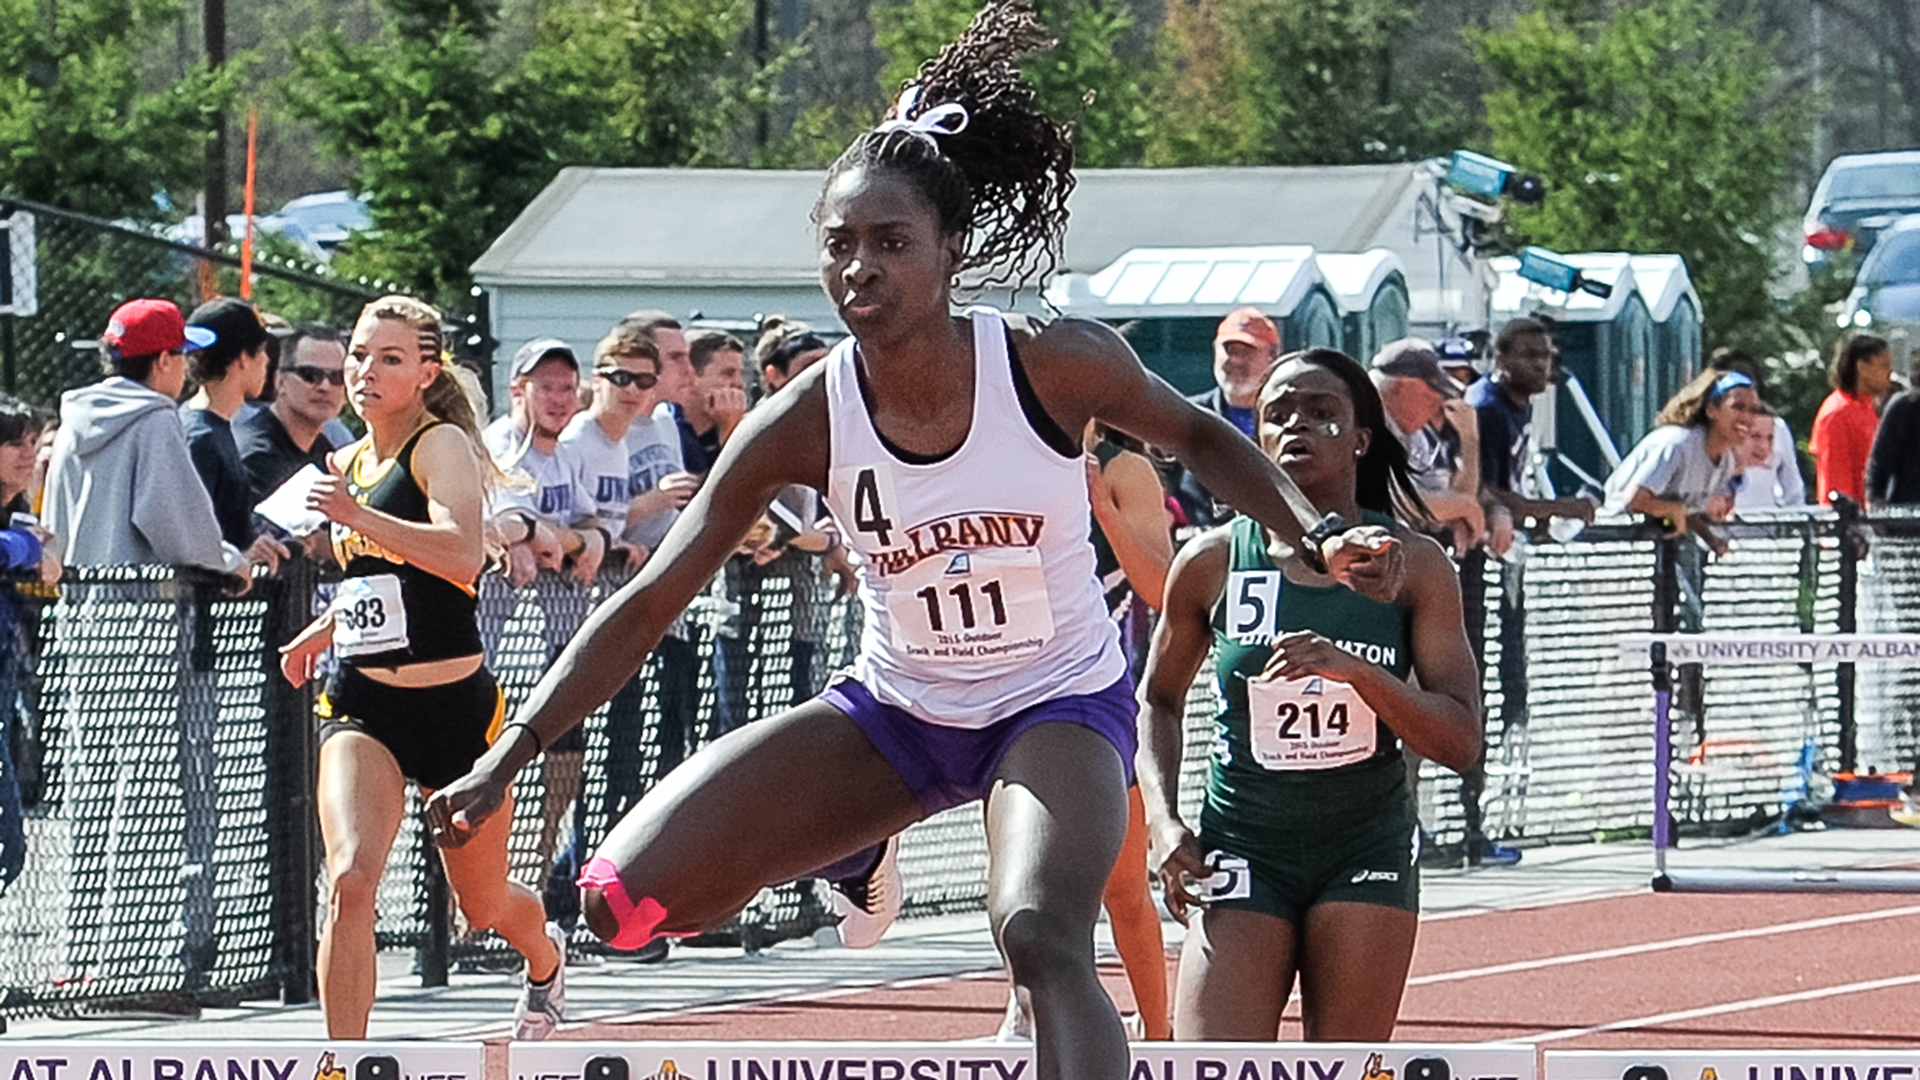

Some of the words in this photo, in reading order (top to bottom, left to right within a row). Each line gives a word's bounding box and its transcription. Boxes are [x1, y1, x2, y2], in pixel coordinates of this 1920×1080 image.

[854, 469, 893, 546] 4
[916, 580, 1006, 631] 111
[1237, 576, 1266, 633] 5
[1697, 642, 1819, 658] UNIVERSITY
[1827, 642, 1850, 657] AT
[1277, 703, 1350, 739] 214
[1211, 854, 1240, 897] 5
[11, 1059, 68, 1080] AT
